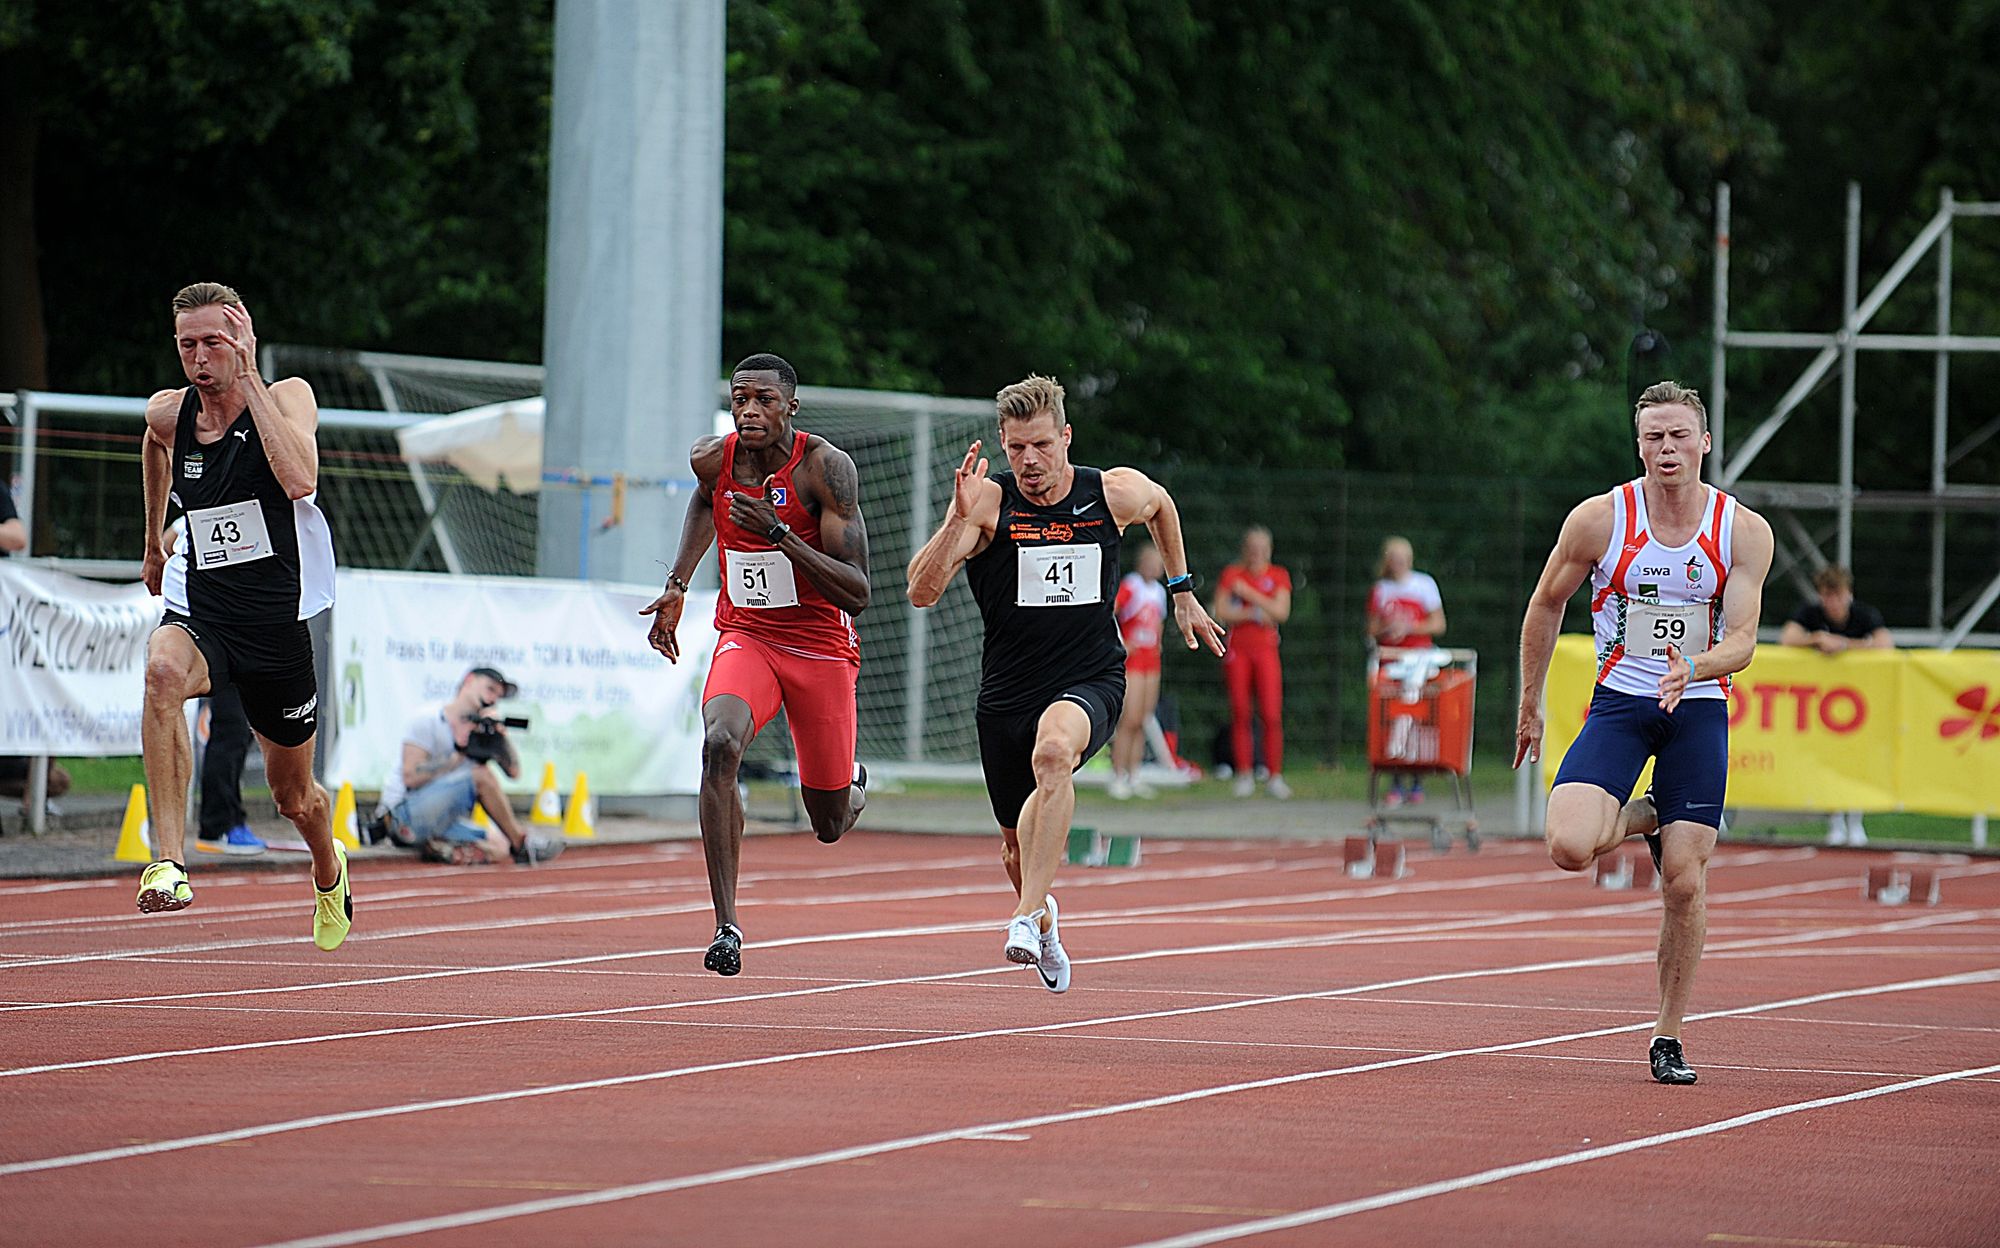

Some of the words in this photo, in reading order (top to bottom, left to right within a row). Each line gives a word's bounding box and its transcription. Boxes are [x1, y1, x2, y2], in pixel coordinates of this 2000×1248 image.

[211, 521, 240, 545] 43
[743, 568, 768, 590] 51
[1045, 562, 1073, 584] 41
[1643, 567, 1670, 576] swa
[746, 598, 767, 606] PUMA
[1046, 595, 1071, 604] PUMA
[1652, 619, 1686, 640] 59
[1651, 648, 1668, 656] PU
[1728, 682, 1868, 734] TTO
